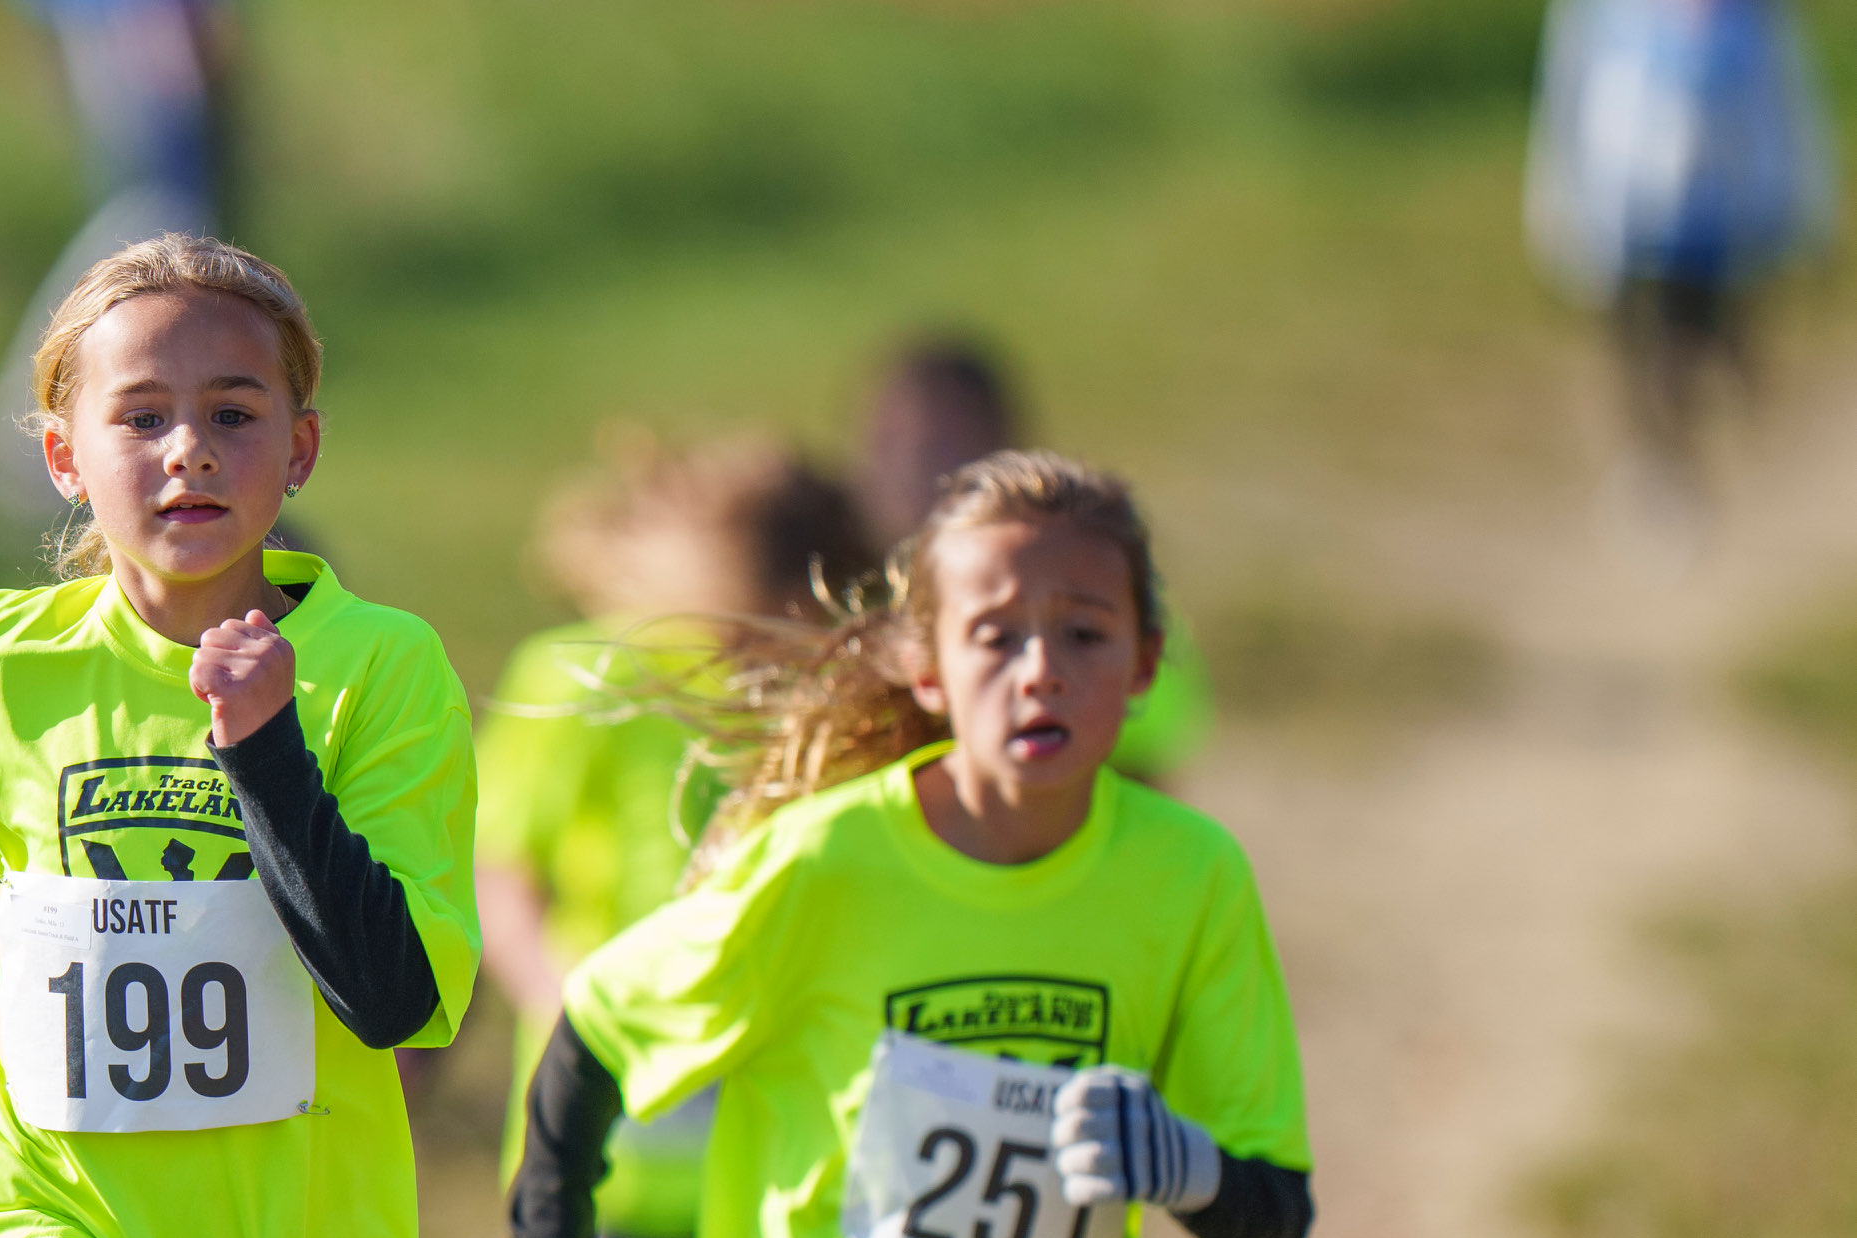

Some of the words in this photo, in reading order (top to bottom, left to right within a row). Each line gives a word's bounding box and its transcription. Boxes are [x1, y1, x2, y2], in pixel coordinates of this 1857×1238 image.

[70, 775, 243, 821] LAKELAN
[160, 774, 224, 793] Track
[93, 898, 178, 934] USATF
[48, 961, 249, 1101] 199
